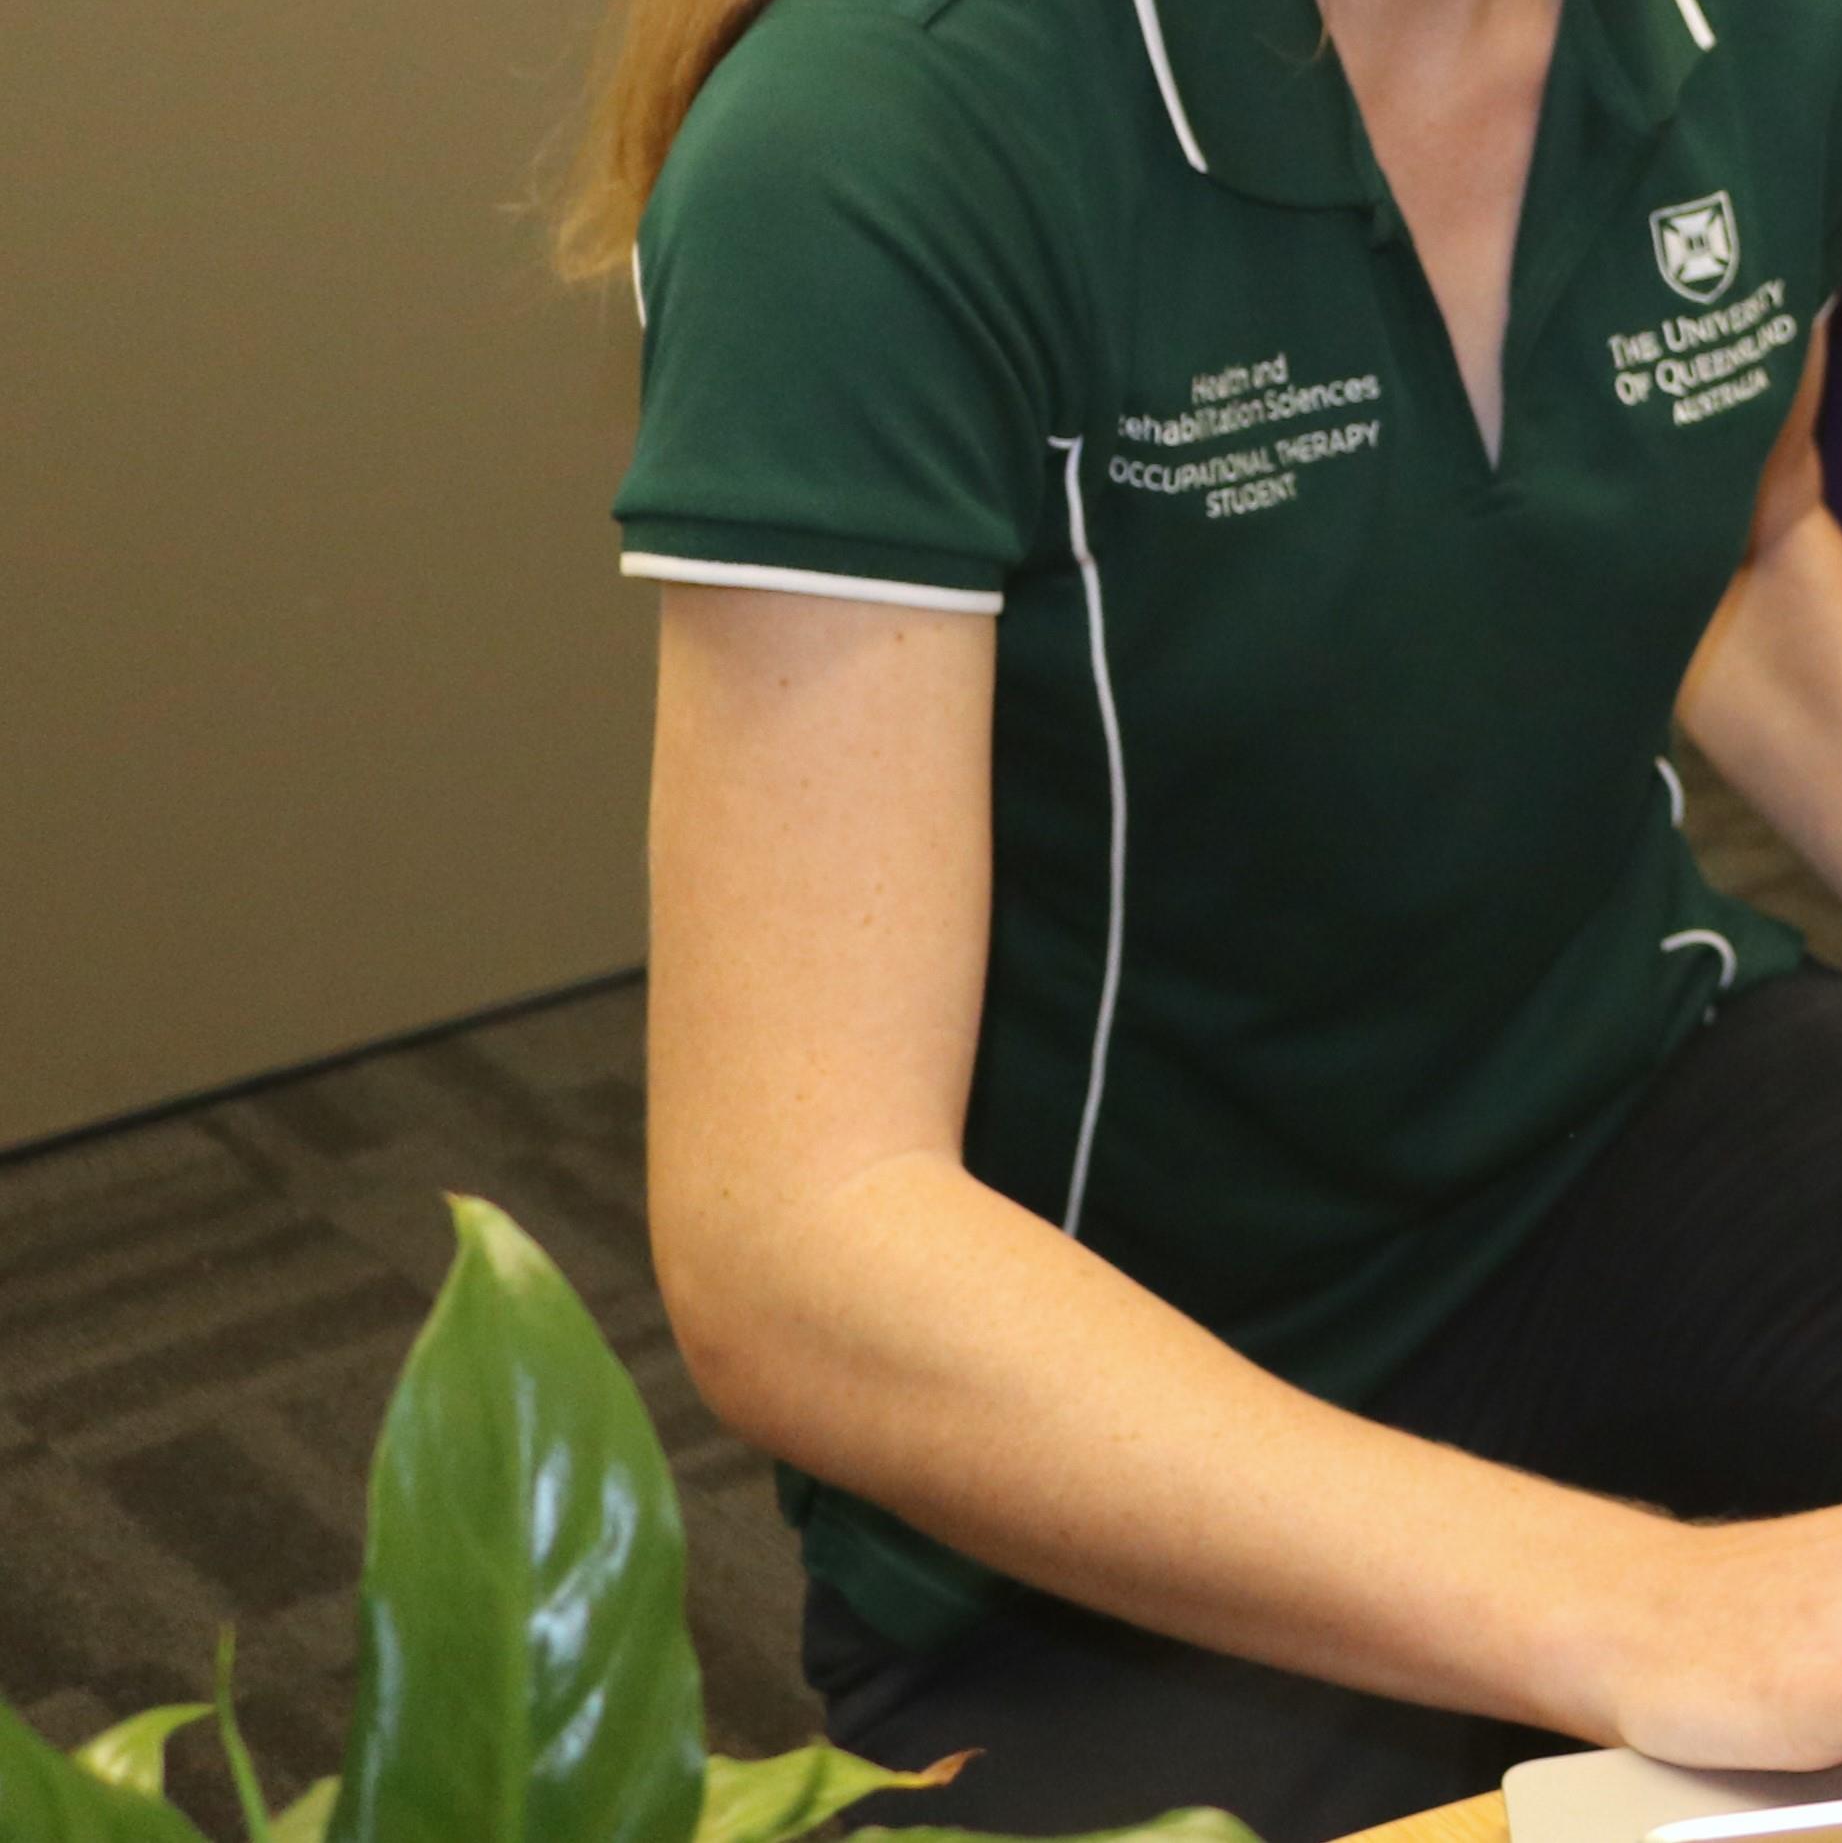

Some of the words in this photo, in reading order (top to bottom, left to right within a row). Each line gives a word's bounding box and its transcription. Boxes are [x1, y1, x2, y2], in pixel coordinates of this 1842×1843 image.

[1608, 331, 1663, 369] THE
[1264, 374, 1381, 422] Sciences
[1614, 371, 1652, 406] OF
[1275, 420, 1381, 464] THERAPY
[1206, 472, 1297, 518] STUDENT
